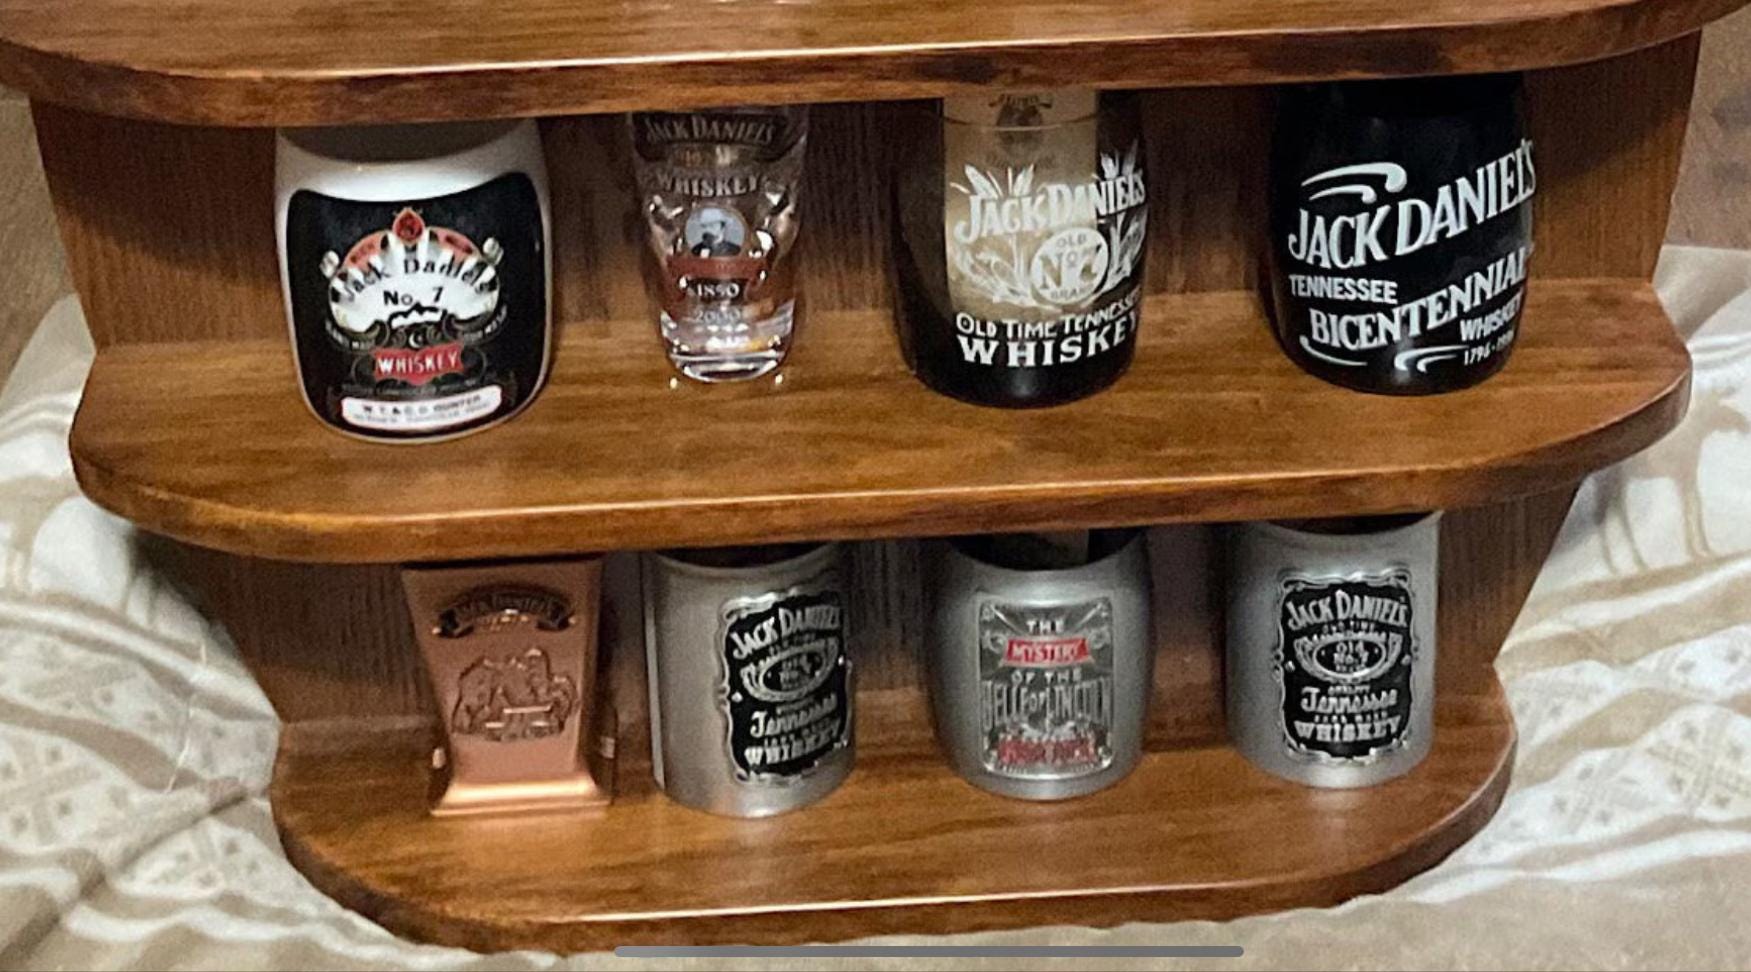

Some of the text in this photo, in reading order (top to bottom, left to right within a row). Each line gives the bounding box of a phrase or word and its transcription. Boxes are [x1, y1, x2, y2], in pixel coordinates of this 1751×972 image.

[953, 193, 1047, 245] JACK
[1056, 232, 1087, 248] OLD
[1289, 208, 1391, 269] JACK
[344, 260, 391, 302] Jack
[1288, 274, 1398, 305] TENNESSEE
[1309, 243, 1534, 350] BICENTENNIAL
[956, 312, 997, 338] OLD
[1002, 317, 1060, 339] TIME
[377, 352, 460, 375] WHISKEY
[1026, 618, 1065, 633] THE
[1286, 597, 1334, 631] JACK
[730, 616, 778, 659] JACK
[1011, 667, 1082, 685] OF THE
[1294, 715, 1402, 742] WHISKEY
